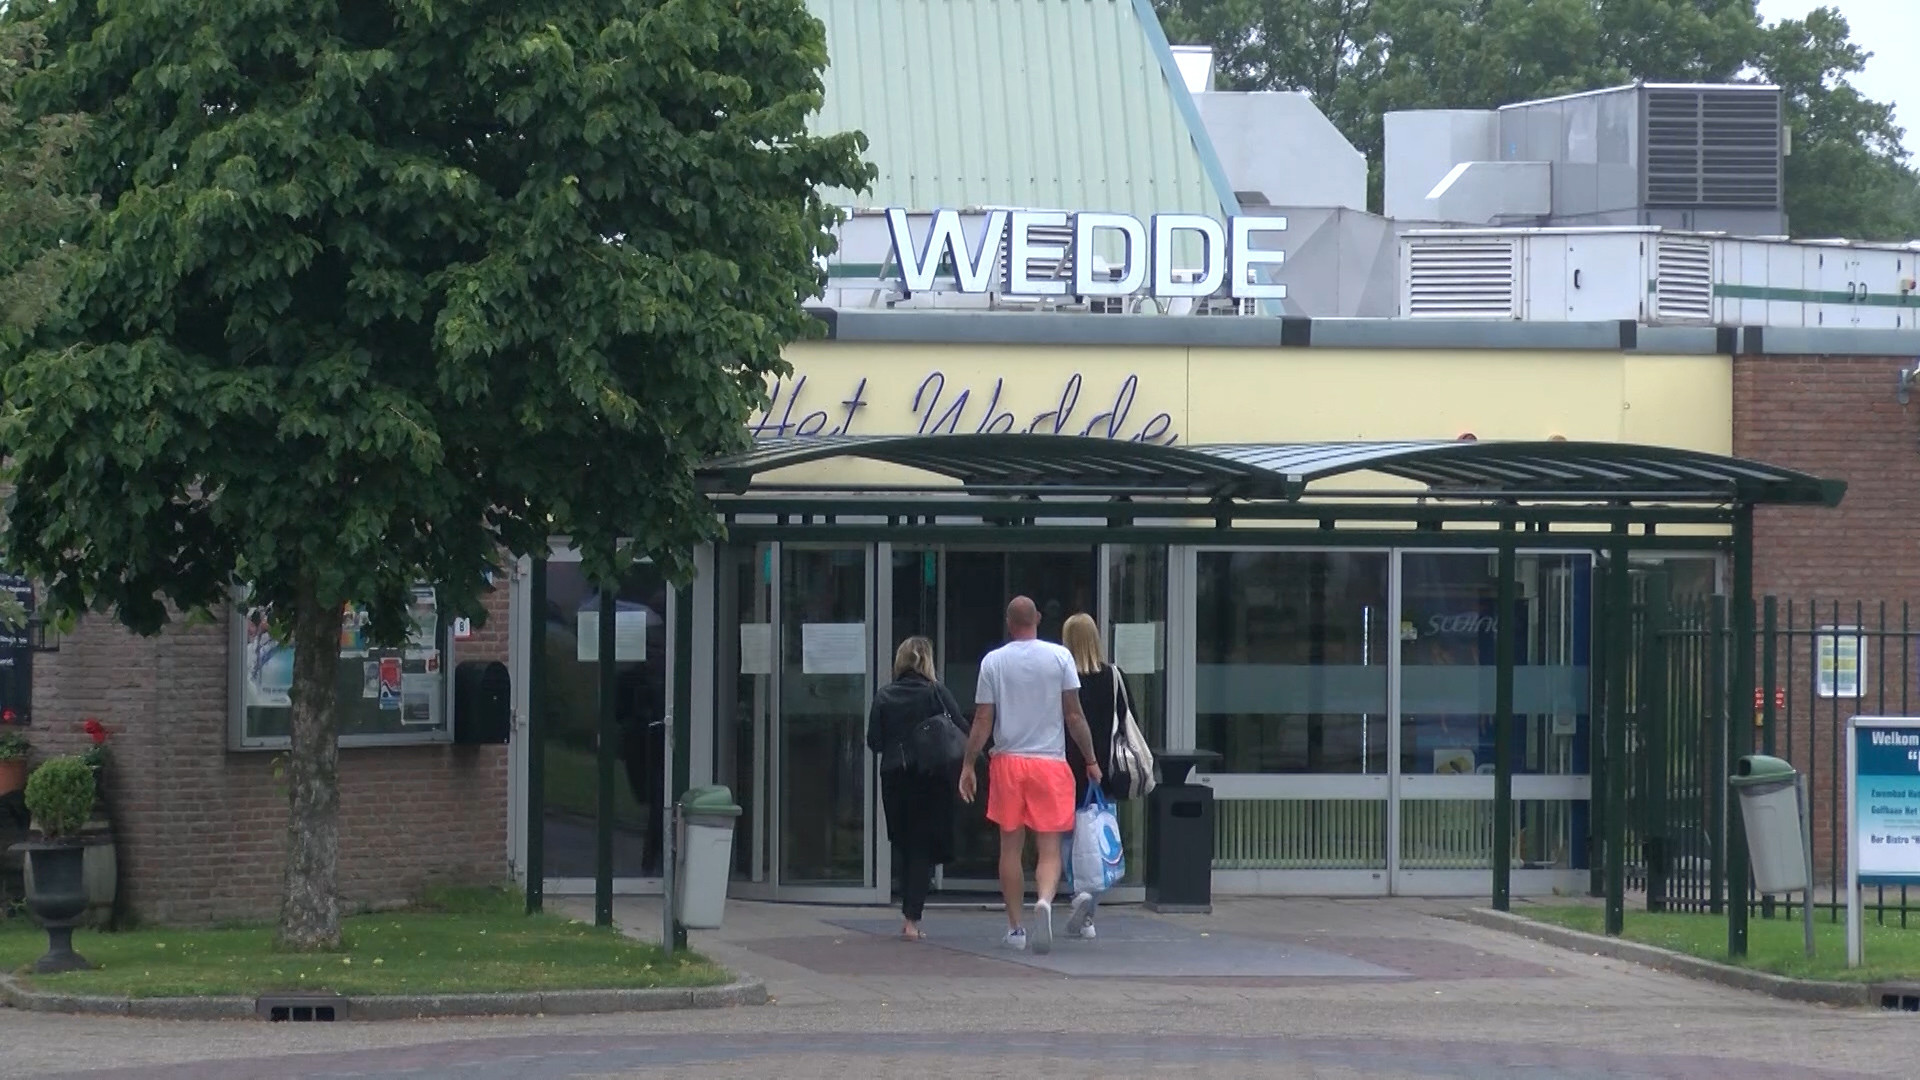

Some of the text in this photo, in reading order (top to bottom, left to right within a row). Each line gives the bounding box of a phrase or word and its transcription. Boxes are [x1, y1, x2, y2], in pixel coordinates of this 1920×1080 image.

[885, 207, 1288, 299] WEDDE
[745, 371, 1179, 447] Het Wedde
[1871, 731, 1919, 746] Welkom
